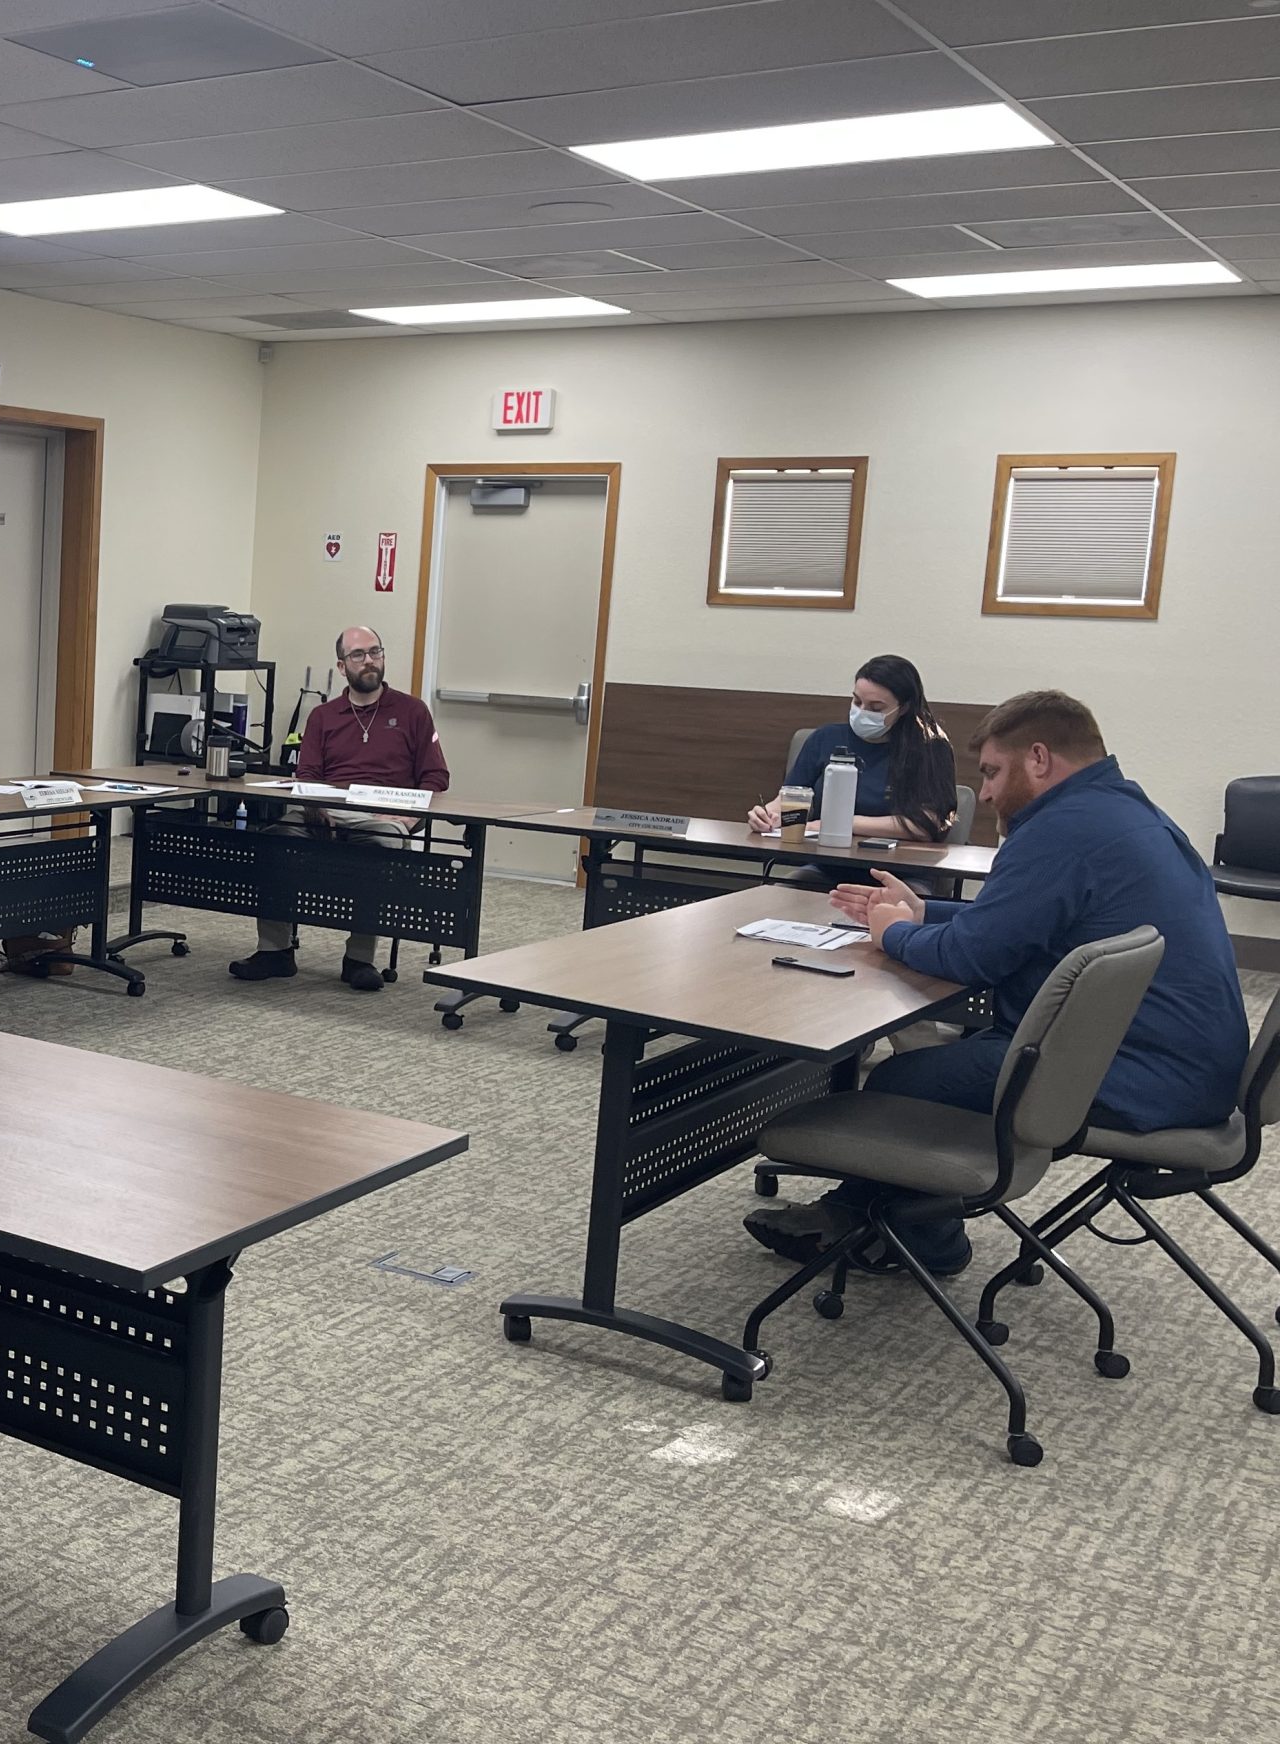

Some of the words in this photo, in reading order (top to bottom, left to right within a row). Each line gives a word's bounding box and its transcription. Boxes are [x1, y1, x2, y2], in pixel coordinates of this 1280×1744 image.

[502, 391, 543, 424] EXIT
[381, 538, 393, 546] FIRE
[620, 813, 649, 821] JESSICA
[651, 816, 684, 824] ANDRADE
